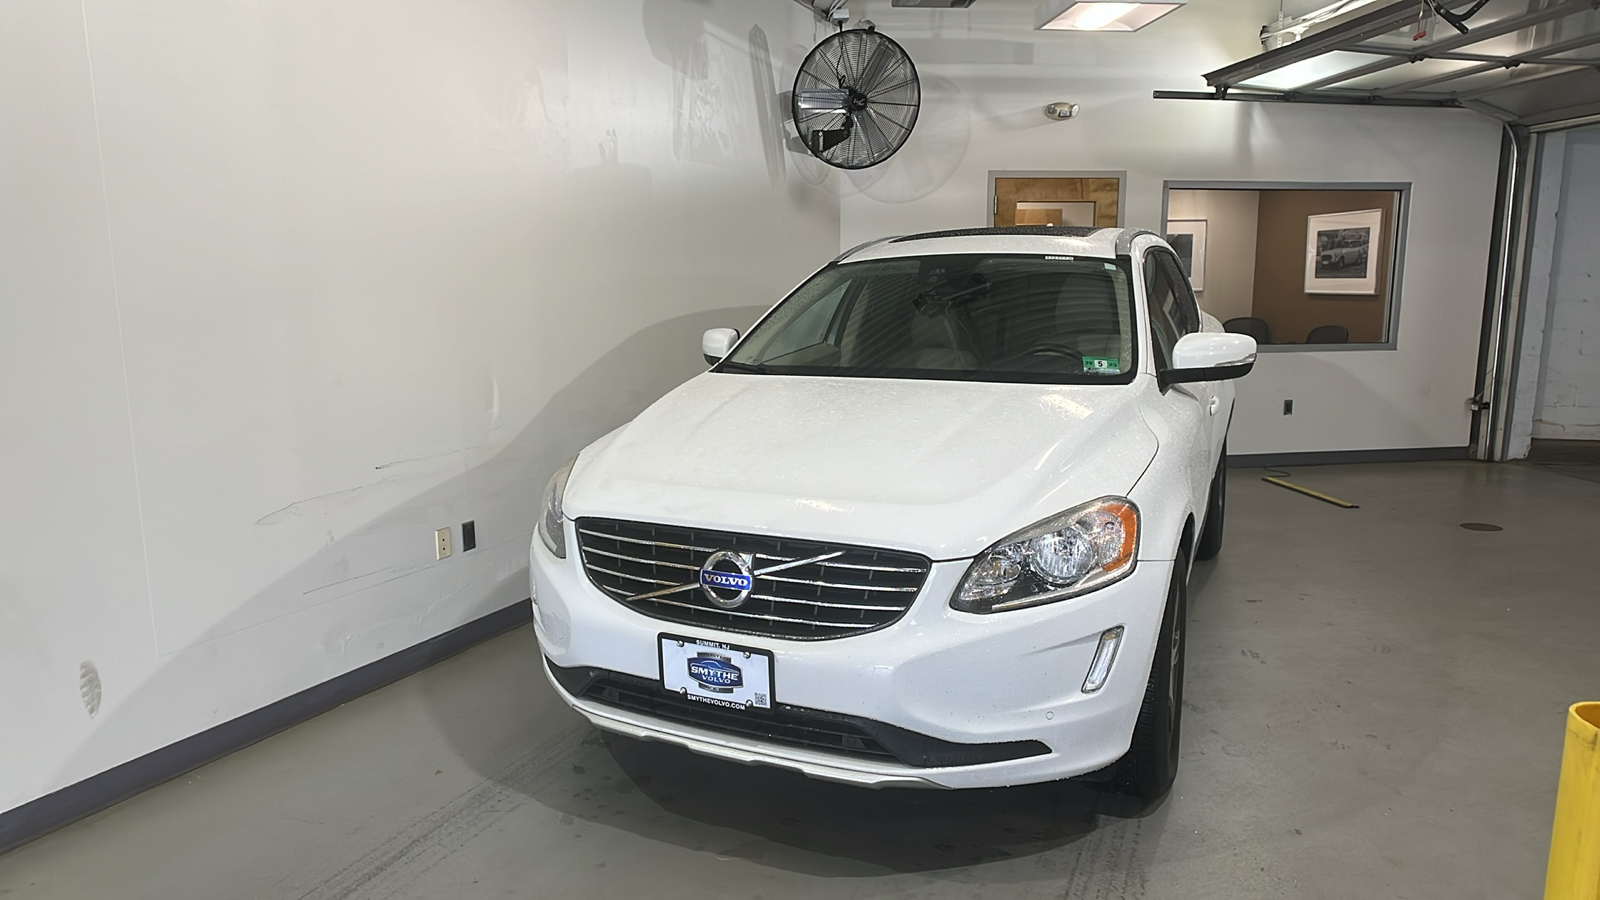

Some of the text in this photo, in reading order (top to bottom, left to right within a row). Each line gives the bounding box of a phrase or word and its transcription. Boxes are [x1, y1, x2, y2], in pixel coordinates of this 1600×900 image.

[703, 573, 748, 587] VOLVO
[691, 666, 739, 681] SMYTHE
[702, 674, 731, 684] VOLVO
[687, 694, 746, 711] SMYTHEVOLVO.COM
